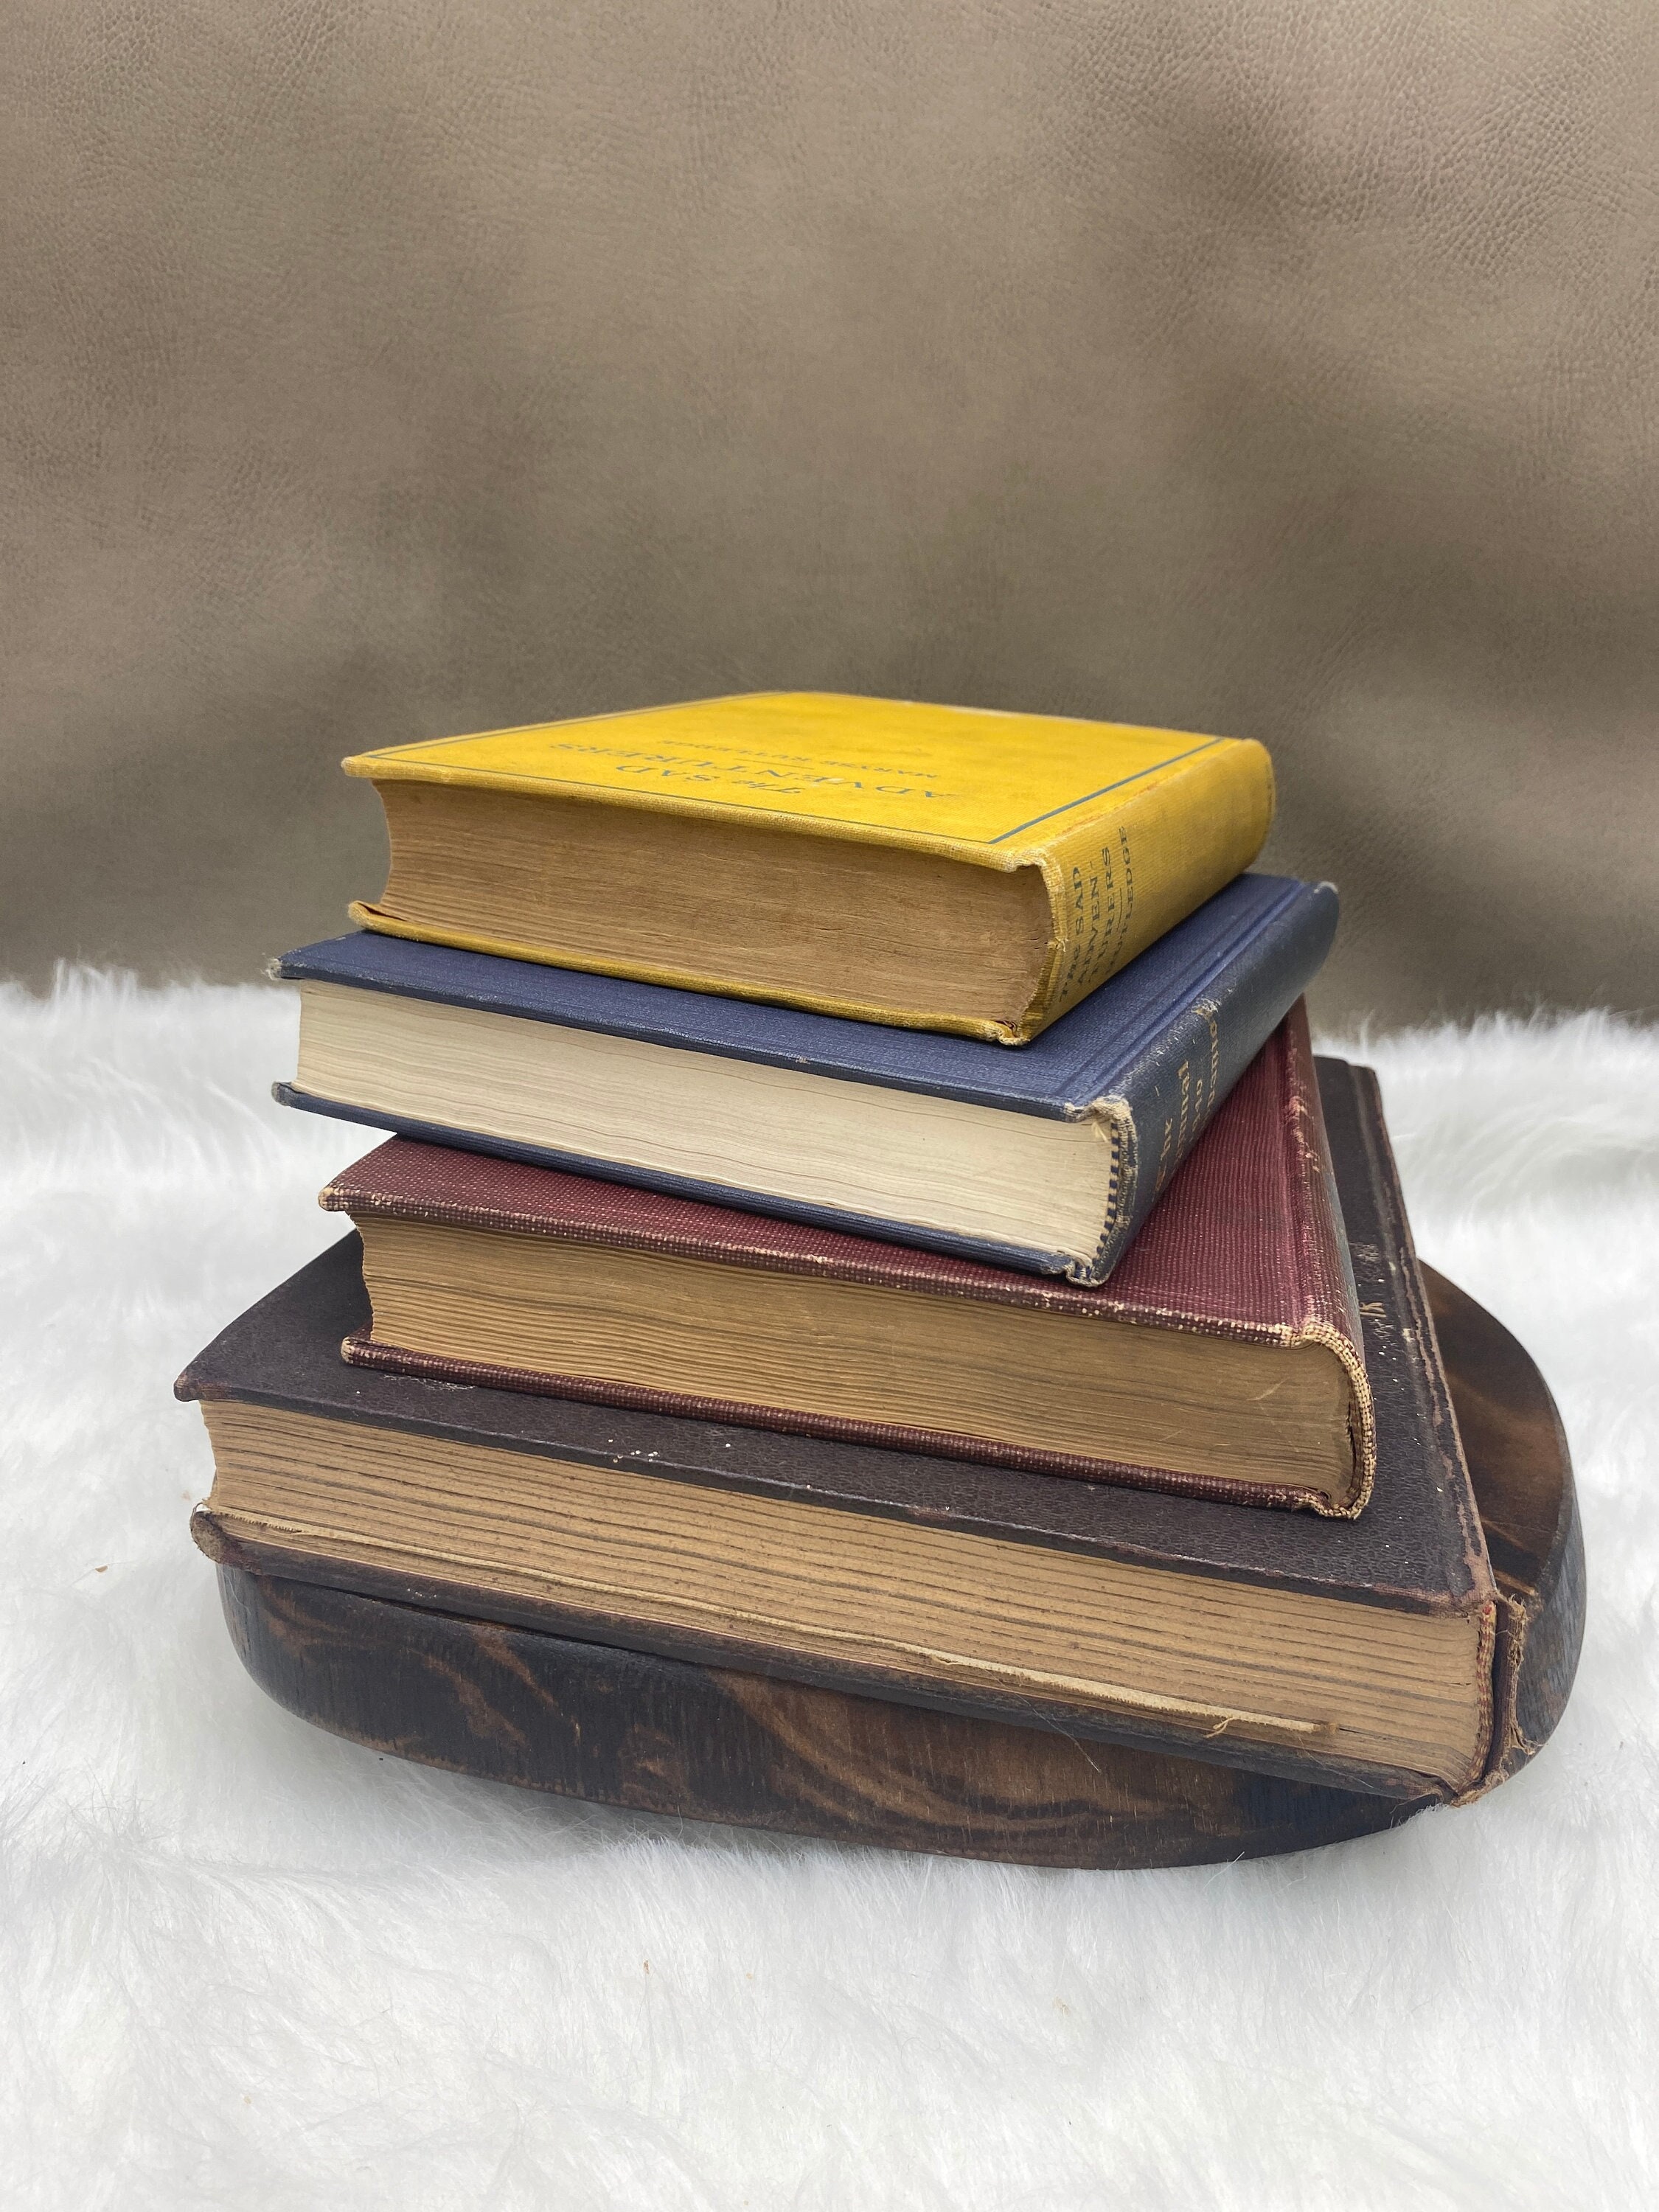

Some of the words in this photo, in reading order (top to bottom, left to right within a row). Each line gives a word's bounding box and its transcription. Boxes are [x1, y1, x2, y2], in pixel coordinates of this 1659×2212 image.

[661, 740, 812, 762] RUTLEDGE
[549, 743, 960, 799] ADVENTURERS
[615, 764, 720, 782] SAD
[731, 779, 807, 795] The
[1071, 866, 1085, 936] SAD
